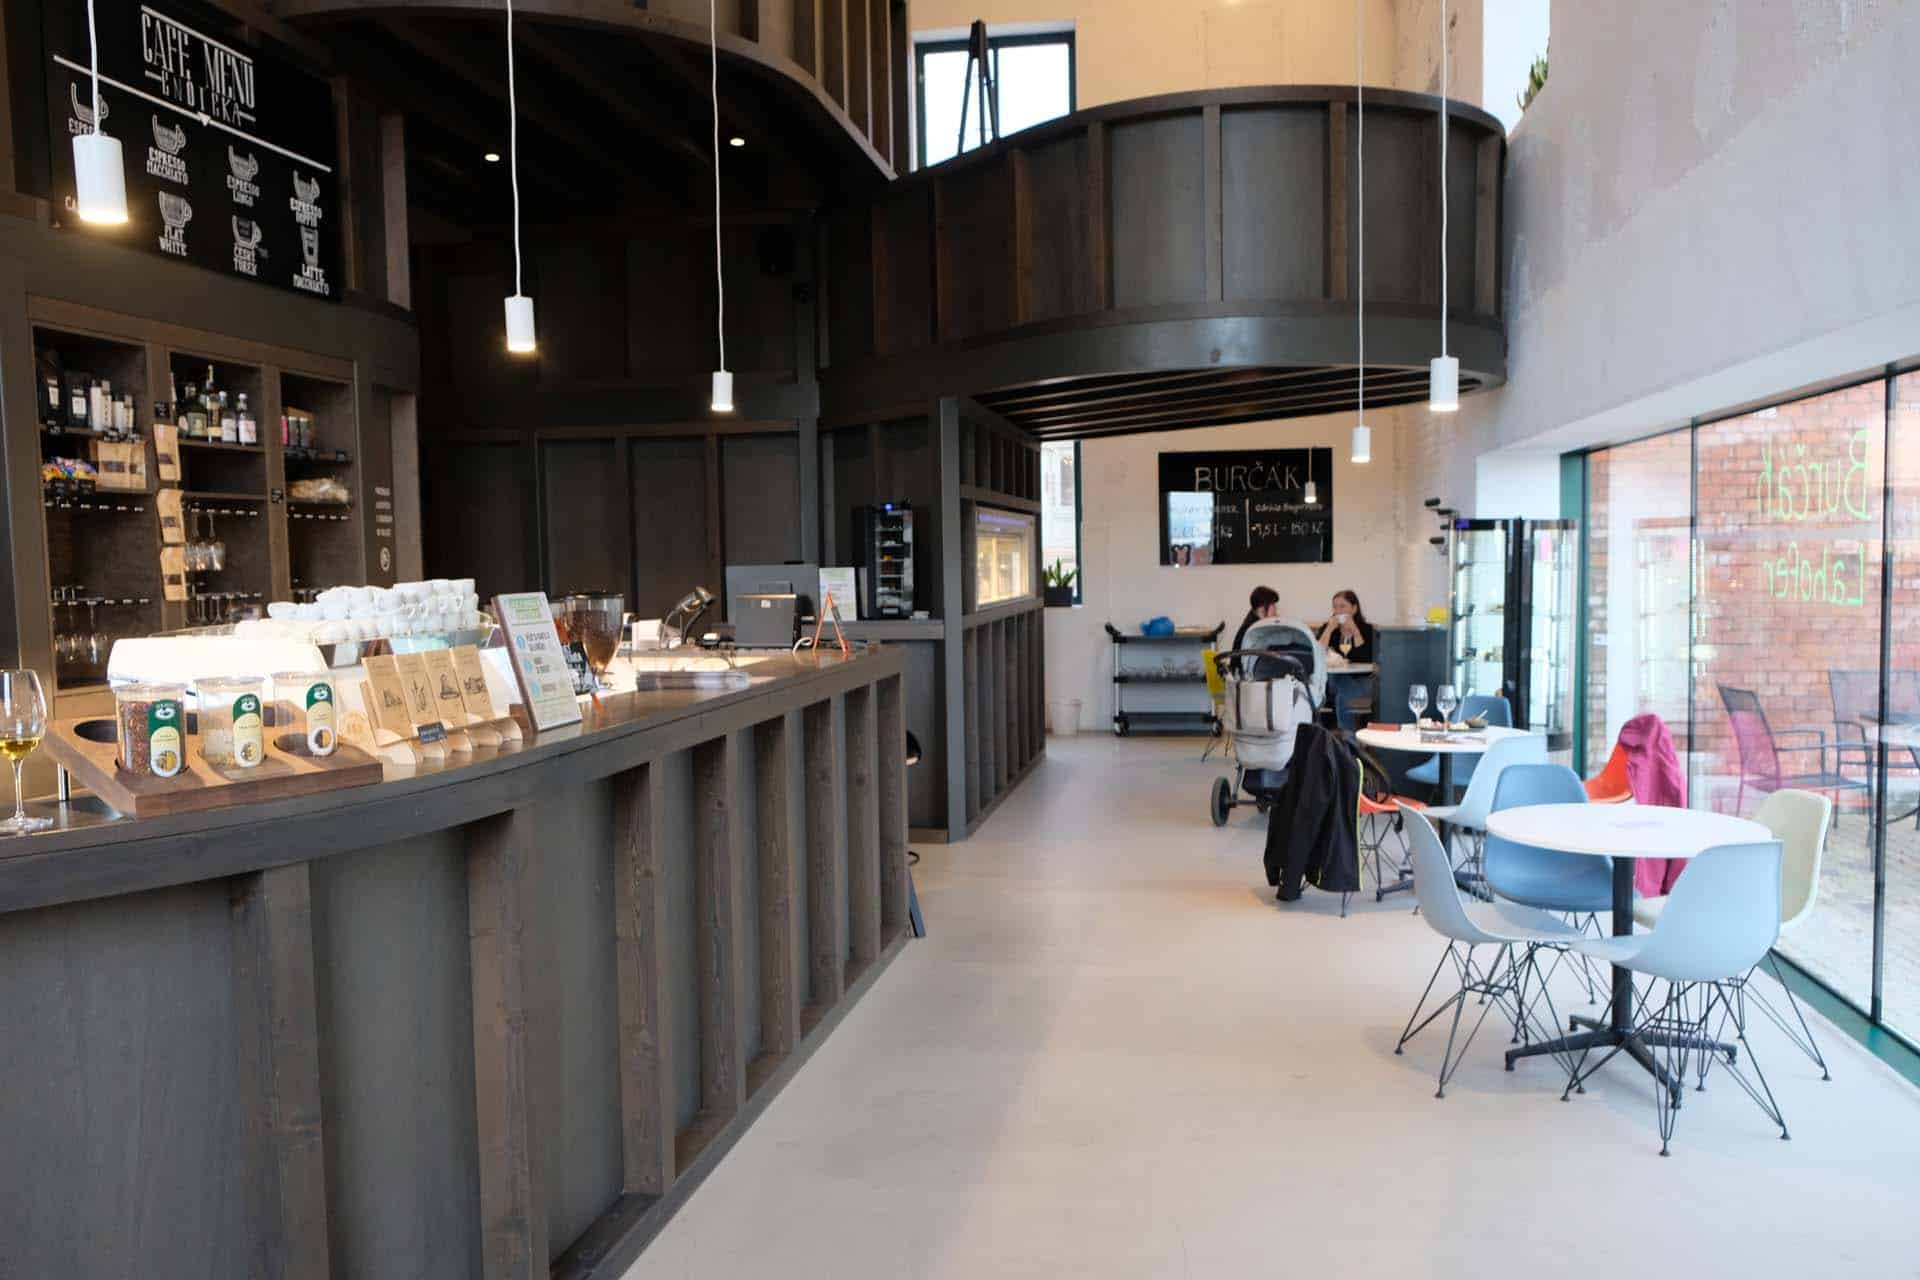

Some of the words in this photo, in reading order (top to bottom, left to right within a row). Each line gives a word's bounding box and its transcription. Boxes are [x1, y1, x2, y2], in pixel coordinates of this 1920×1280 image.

[203, 42, 255, 109] MENU
[149, 146, 186, 172] ESPRESSO
[164, 224, 185, 241] FLAT
[159, 236, 187, 256] WHITE
